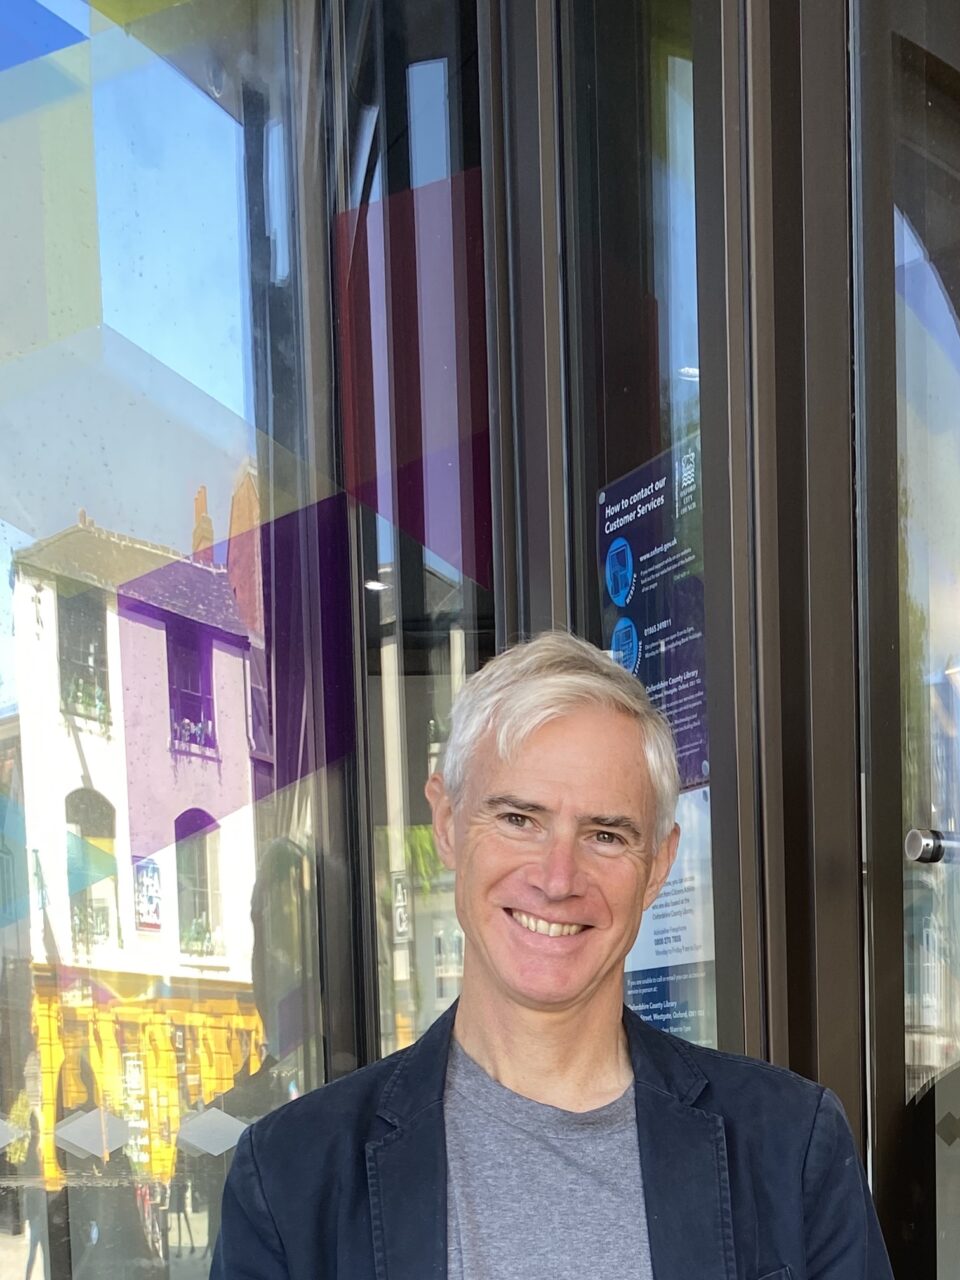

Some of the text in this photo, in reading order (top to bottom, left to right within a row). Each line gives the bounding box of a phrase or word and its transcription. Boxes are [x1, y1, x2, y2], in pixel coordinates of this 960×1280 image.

[604, 495, 665, 534] Customer Services
[605, 476, 667, 518] How to contact our
